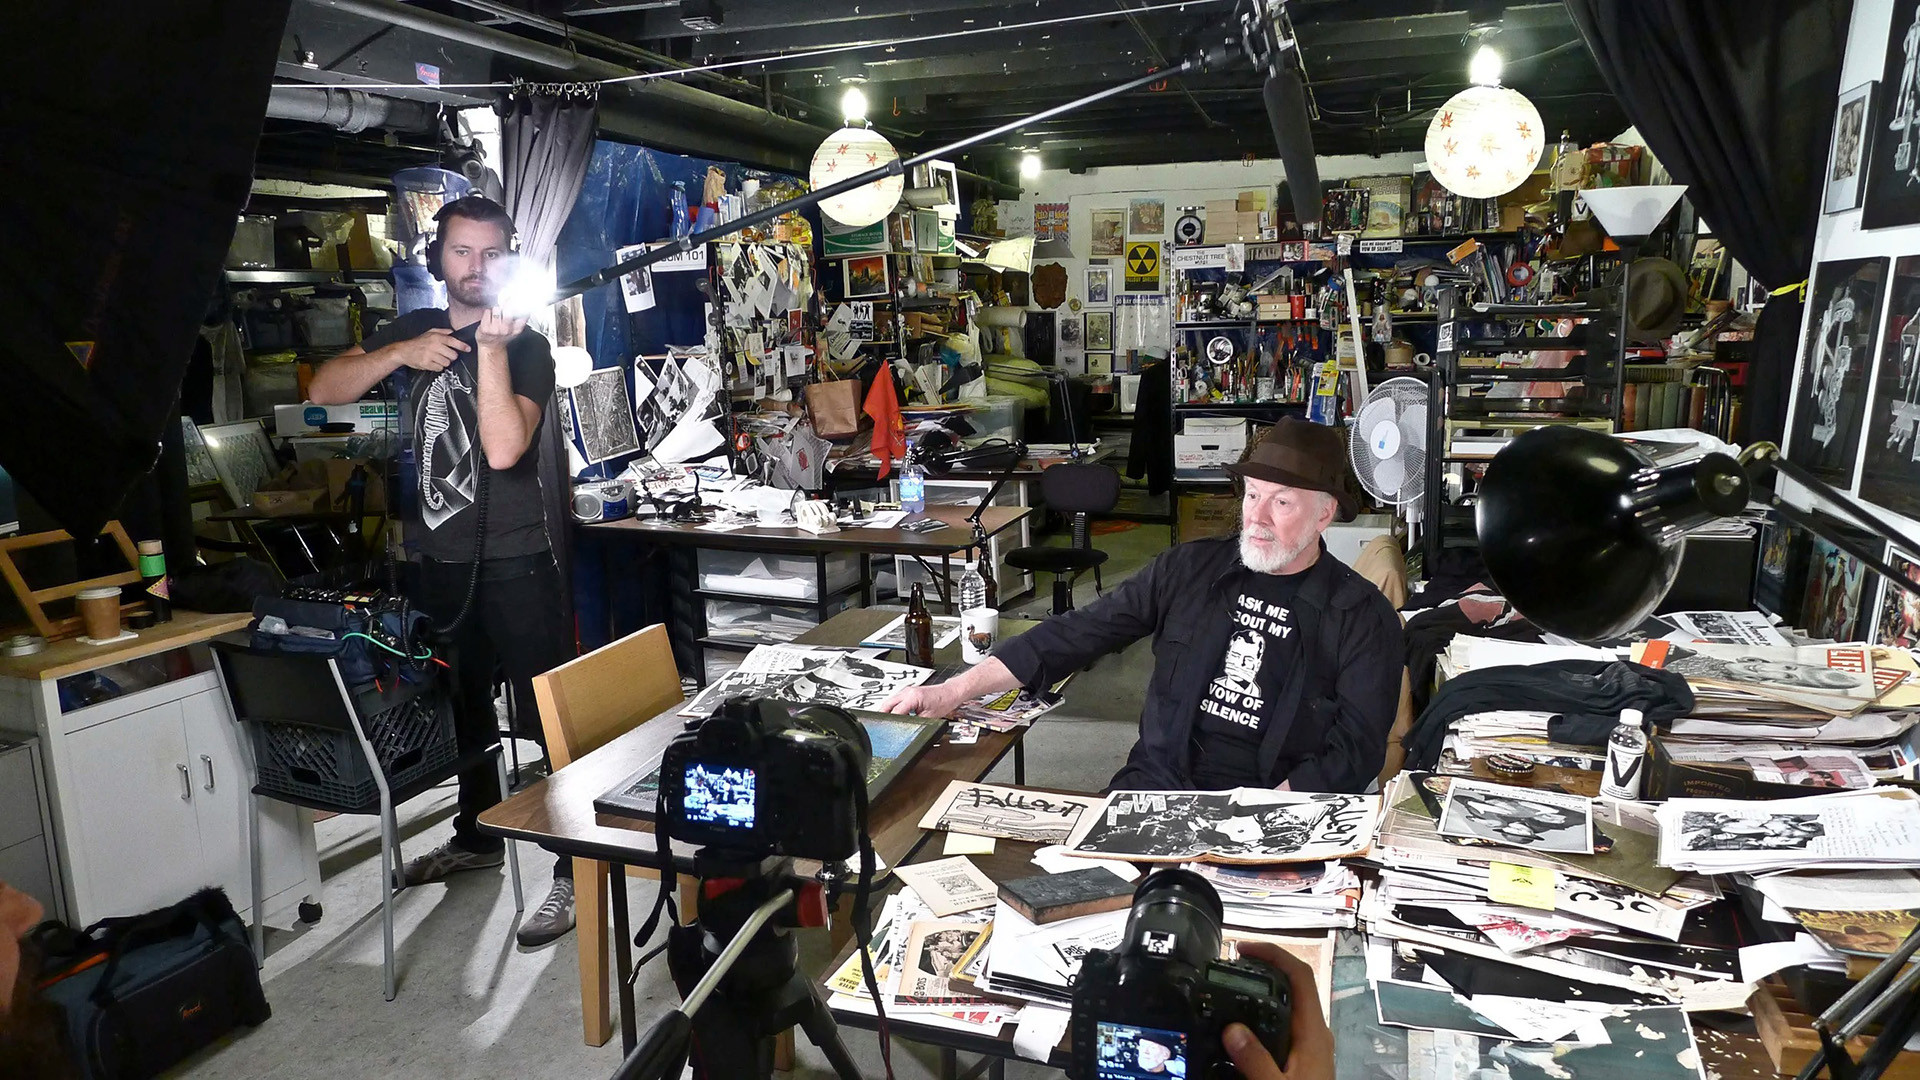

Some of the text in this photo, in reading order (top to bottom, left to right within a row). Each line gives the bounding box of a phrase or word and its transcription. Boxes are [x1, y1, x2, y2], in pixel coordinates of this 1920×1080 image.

[686, 250, 704, 260] 101
[1238, 594, 1290, 622] ASK ME
[1267, 622, 1292, 639] MY
[1209, 683, 1264, 711] VOW OF
[1200, 699, 1260, 730] SILENCE
[1611, 749, 1642, 788] V
